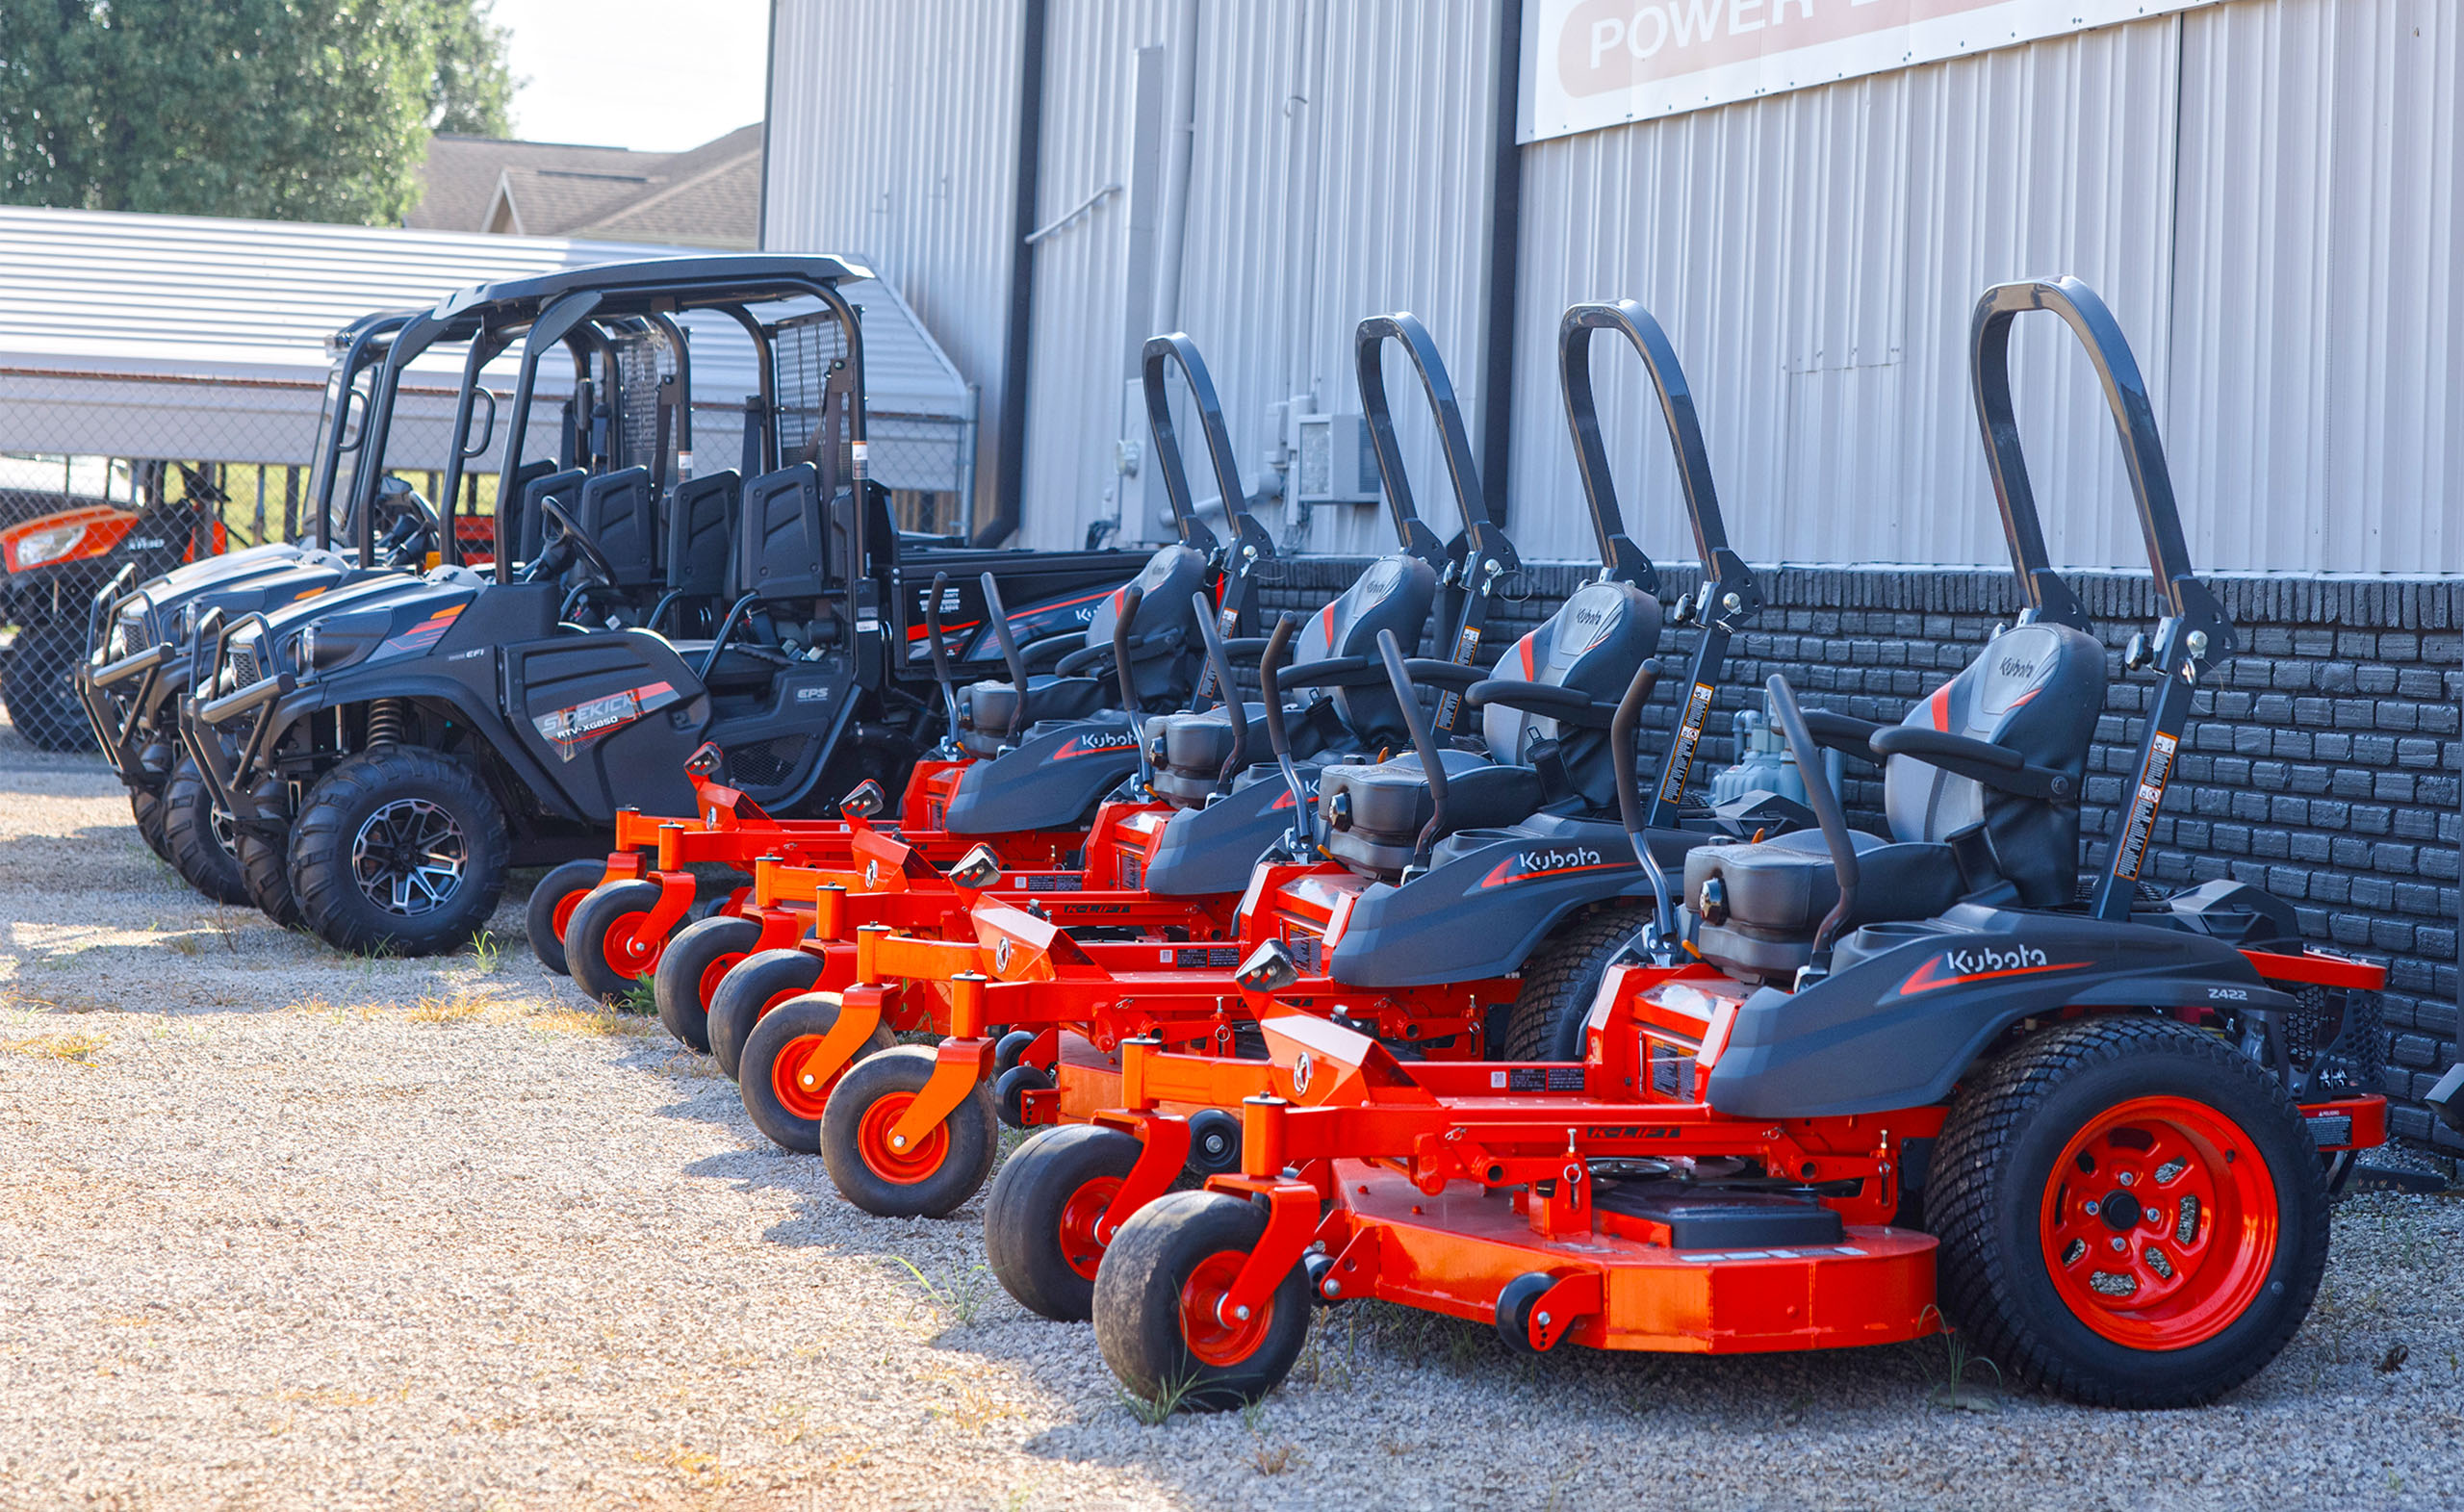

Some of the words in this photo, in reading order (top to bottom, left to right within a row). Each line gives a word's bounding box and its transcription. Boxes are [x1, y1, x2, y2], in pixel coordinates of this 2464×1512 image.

[1999, 656, 2034, 678] Kubota
[797, 687, 829, 699] EPS
[557, 715, 619, 739] RTV-XG850
[1082, 731, 1136, 748] Kubot
[1520, 847, 1602, 871] Kubota
[1947, 944, 2048, 975] Kubota
[2208, 988, 2248, 1001] Z422
